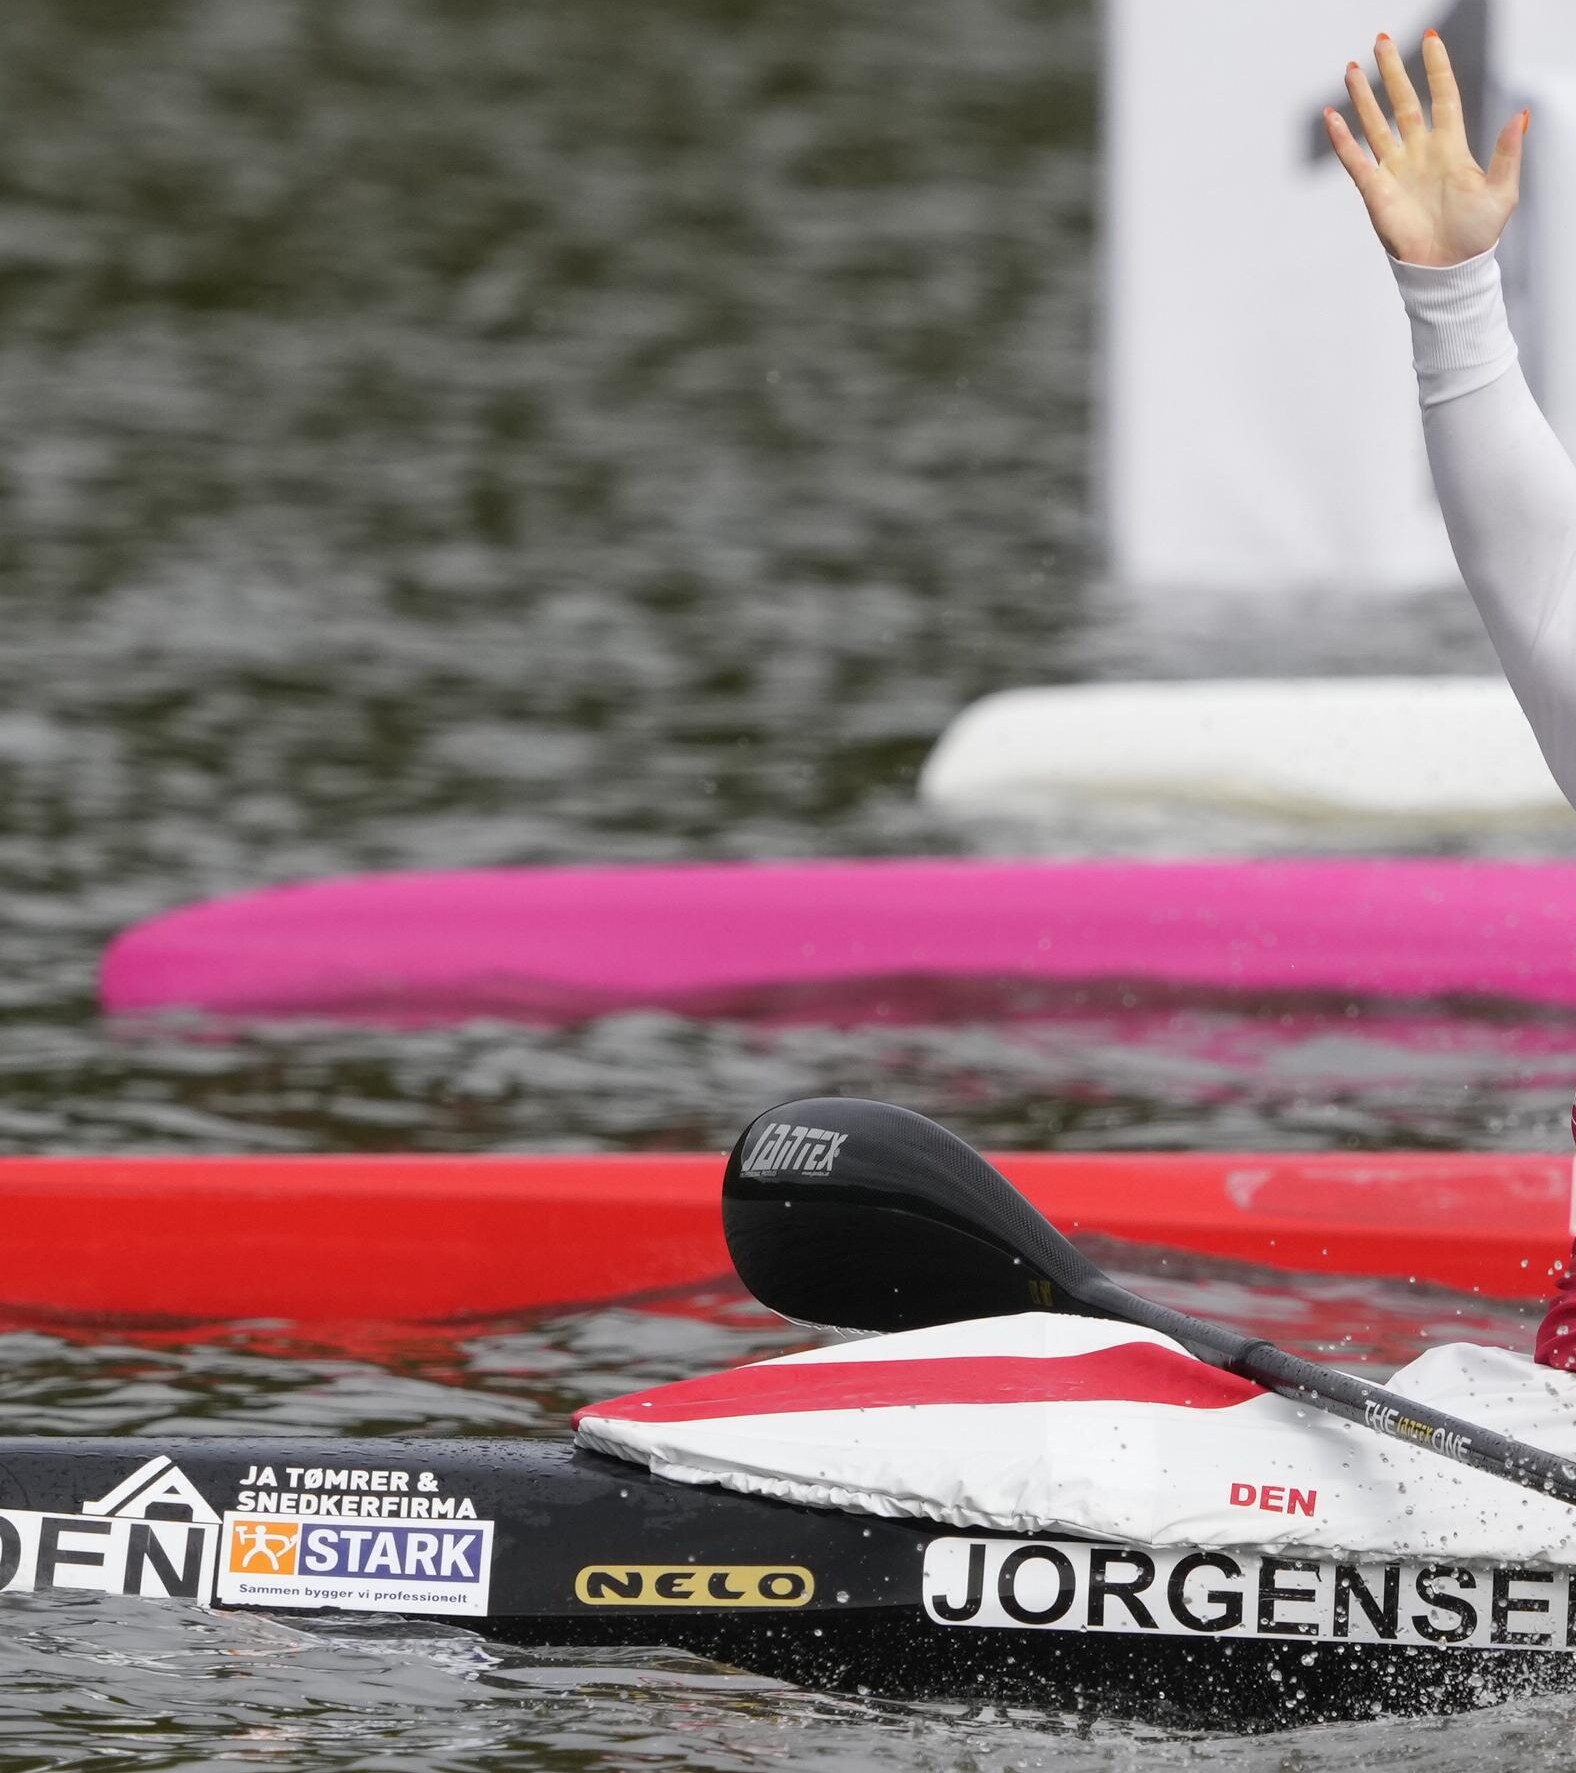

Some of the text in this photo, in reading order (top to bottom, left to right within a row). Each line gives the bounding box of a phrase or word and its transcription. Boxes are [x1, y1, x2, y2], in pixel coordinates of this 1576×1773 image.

[1364, 1399, 1400, 1436] THE
[1431, 1426, 1473, 1461] ONE
[239, 1465, 440, 1492] JA TØMRER &
[236, 1490, 478, 1519] SNEDKERFIRMA
[1229, 1482, 1317, 1518] DEN
[304, 1528, 477, 1578] STARK
[239, 1583, 468, 1604] Sammen bygger vi professionelt
[586, 1571, 806, 1601] NELO
